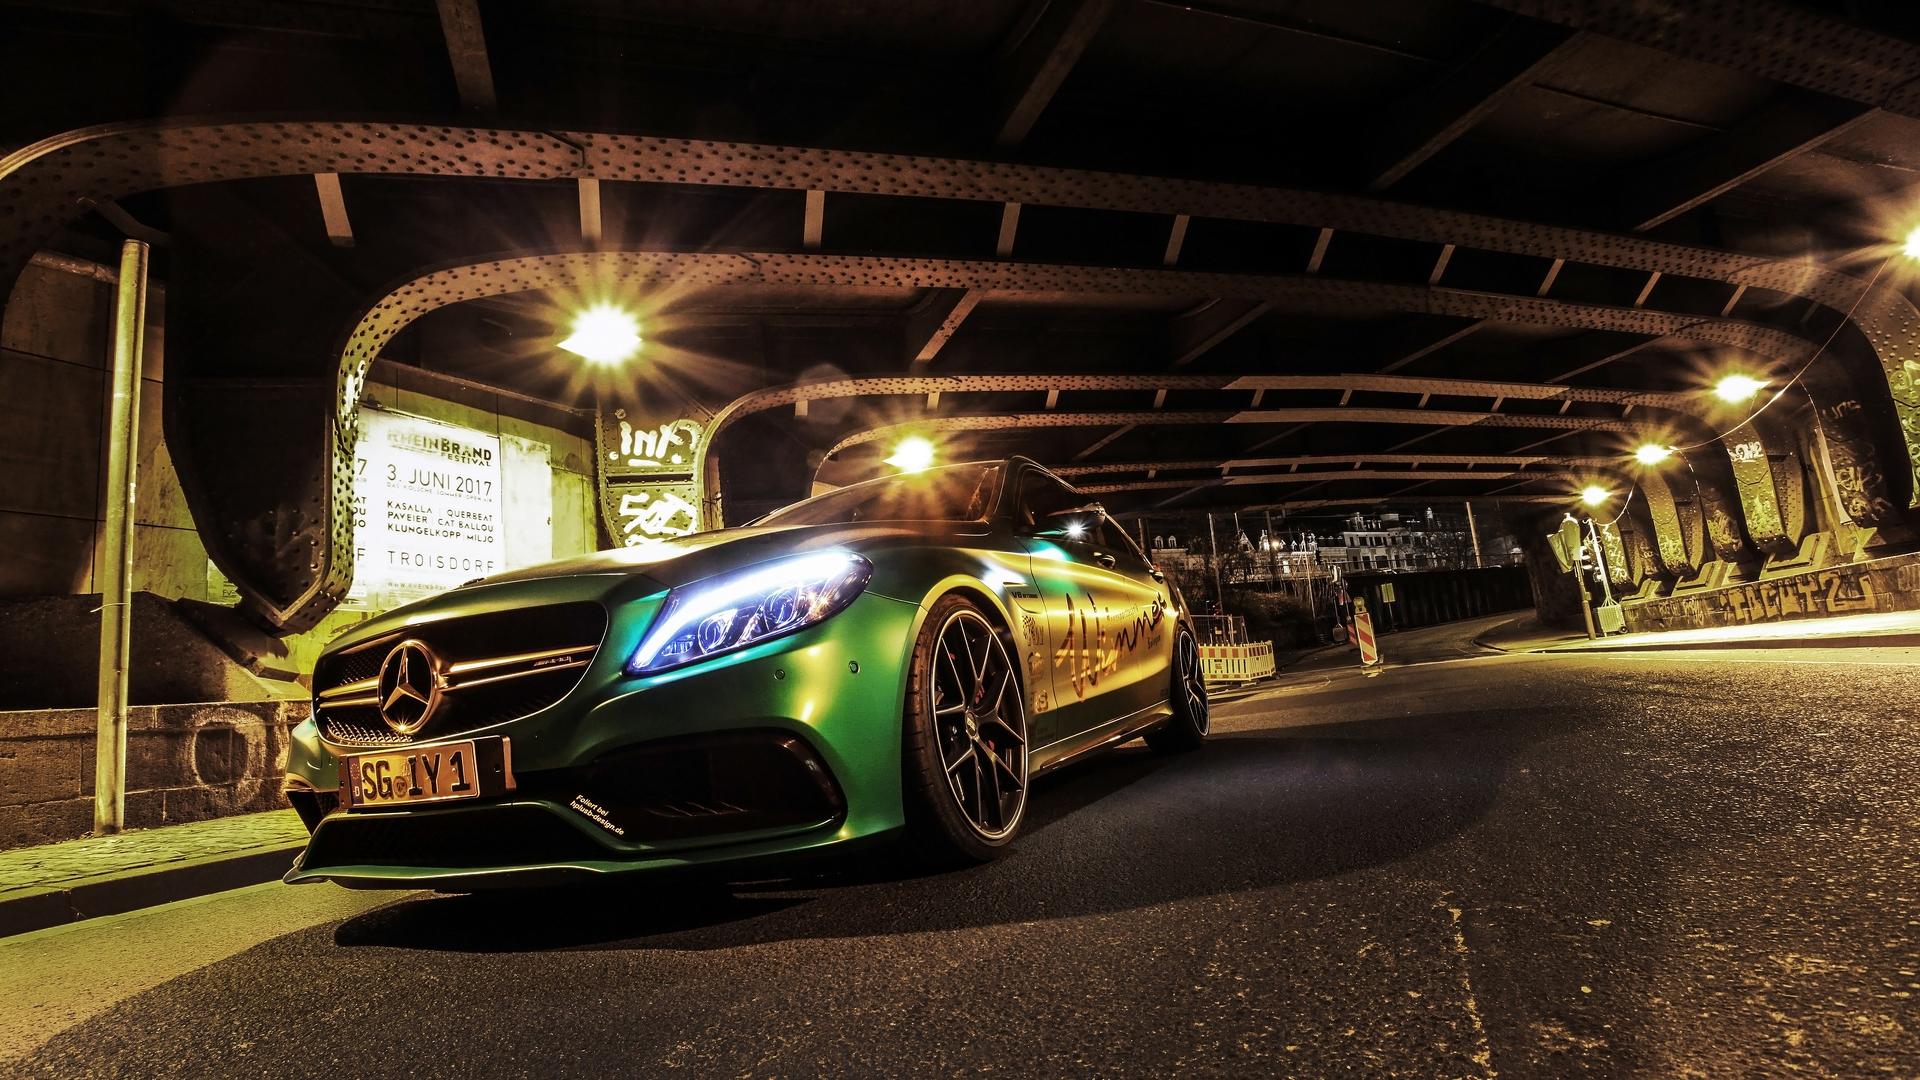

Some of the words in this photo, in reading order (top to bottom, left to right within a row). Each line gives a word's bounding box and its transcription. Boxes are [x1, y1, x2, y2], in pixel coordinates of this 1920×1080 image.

[387, 431, 492, 461] RHEINBRAND
[440, 452, 491, 467] FESTIVAL
[387, 463, 402, 482] 3.
[408, 468, 450, 490] JUNI
[456, 476, 492, 496] 2017
[387, 500, 432, 514] KASALLA
[447, 509, 492, 521] QUERBEAT
[387, 511, 428, 524] PAVEIER
[438, 518, 455, 527] CAT
[458, 520, 494, 532] BALLOU
[387, 550, 494, 573] TROISDORF
[362, 760, 394, 800] SG
[407, 753, 441, 797] IY
[449, 750, 471, 792] 1
[576, 794, 598, 810] Foliert
[597, 807, 609, 817] bei
[570, 800, 625, 835] hplusb-design.de
